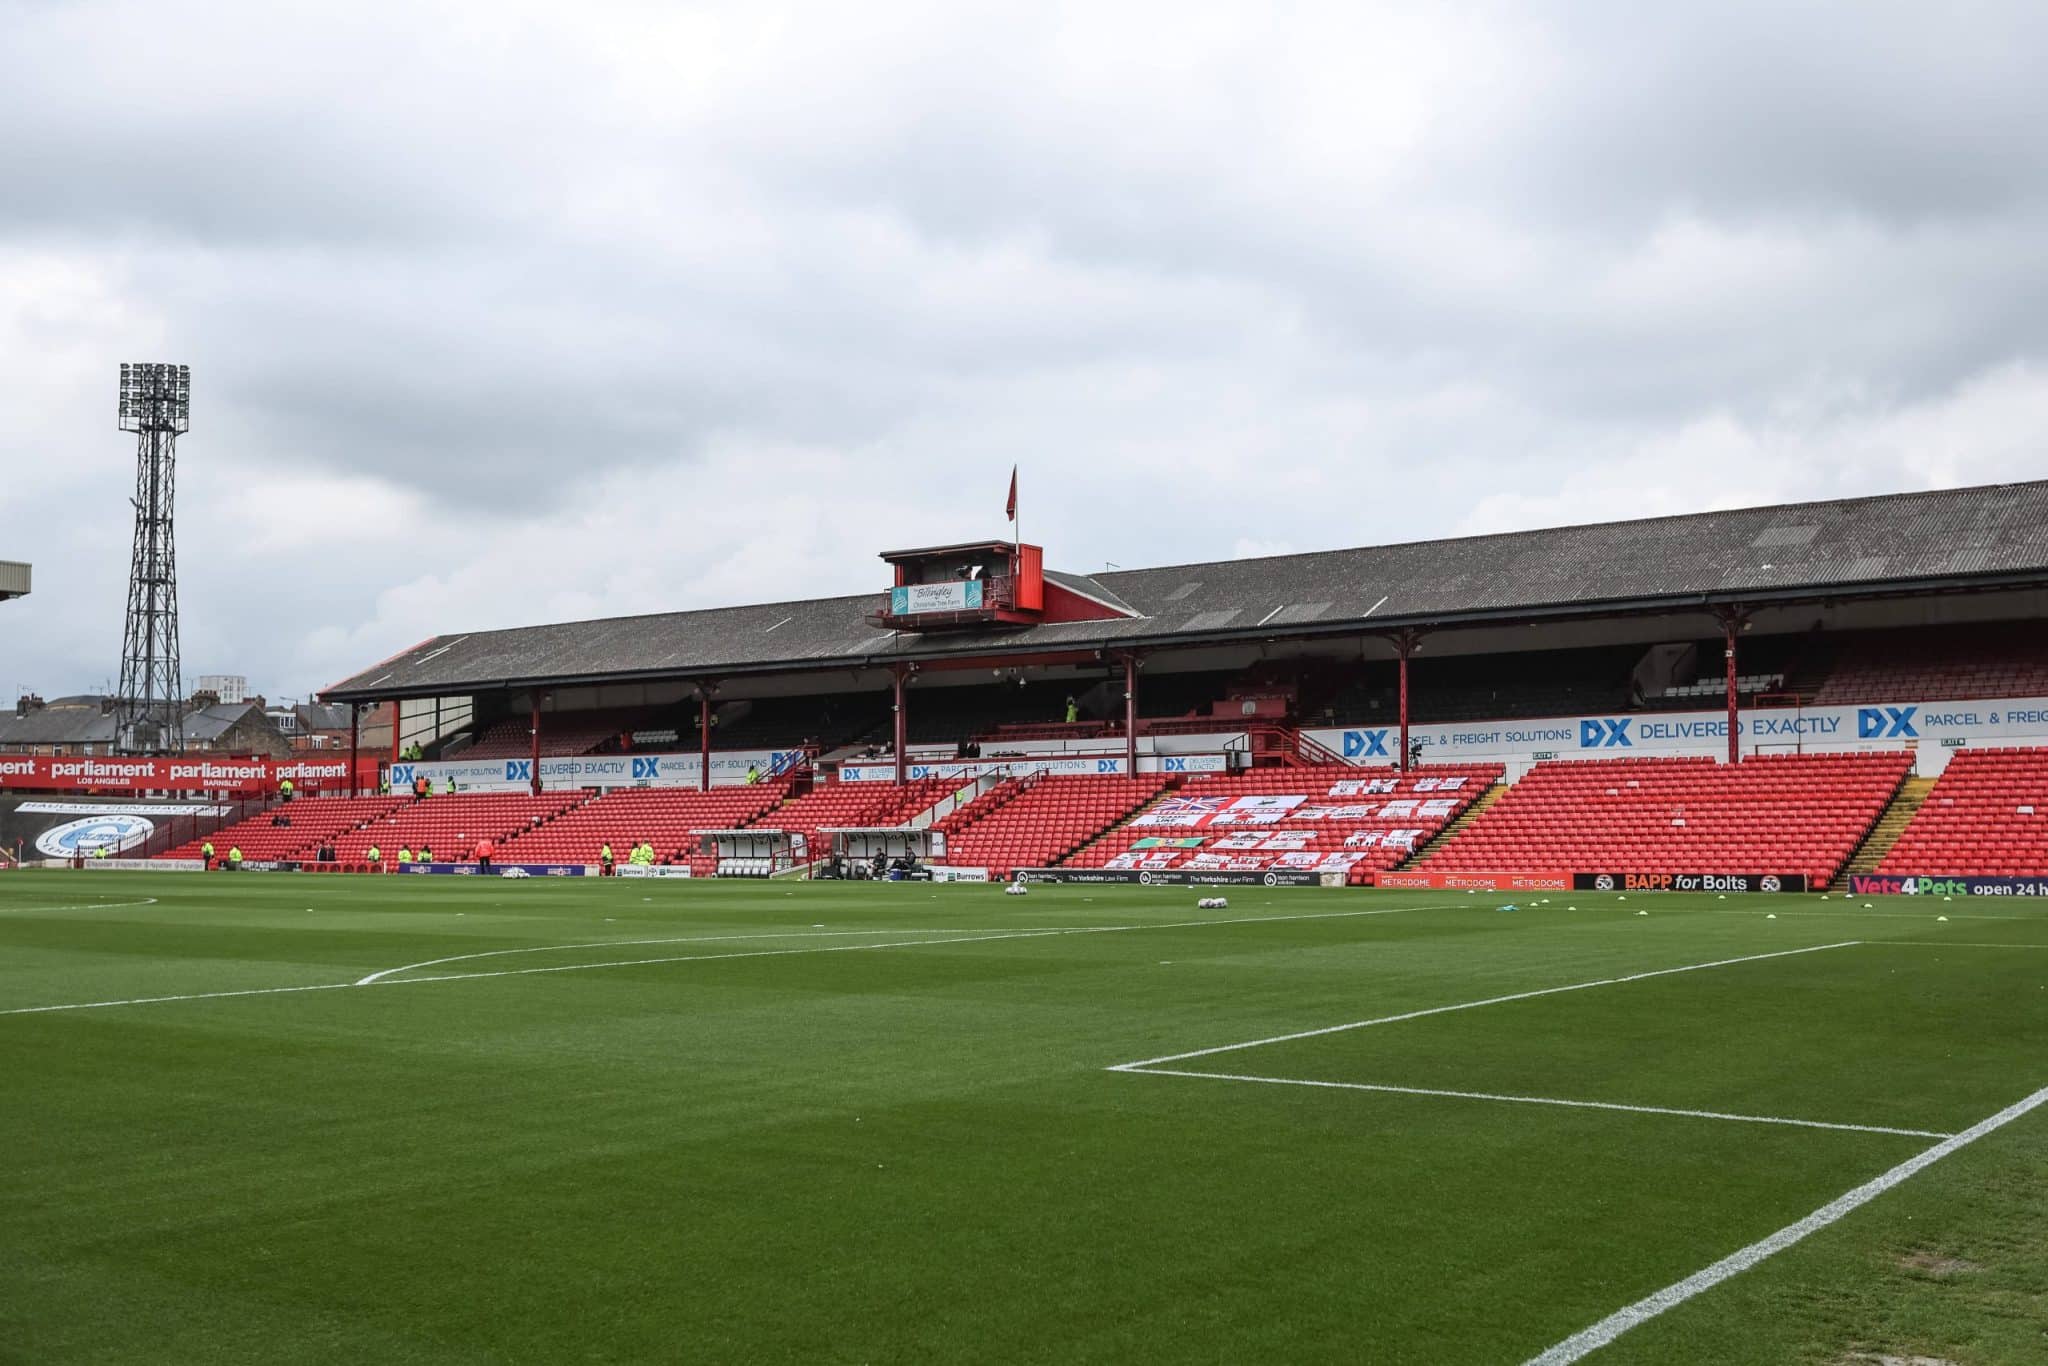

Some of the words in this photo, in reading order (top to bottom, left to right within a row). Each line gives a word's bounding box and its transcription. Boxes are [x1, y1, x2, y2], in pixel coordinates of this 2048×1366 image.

[917, 585, 952, 600] Billingley
[1858, 706, 1919, 738] DX
[1925, 712, 1983, 726] PARCEL
[1989, 712, 2000, 724] &
[1580, 718, 1632, 747] DX
[1753, 716, 1841, 735] EXACTLY
[1344, 729, 1388, 757] DX
[1392, 735, 1435, 747] PRCEL
[1439, 734, 1448, 745] &
[1452, 732, 1500, 745] FREIGHT
[1505, 730, 1572, 743] SOLUTIONS
[0, 759, 36, 775] ent
[51, 760, 155, 779] parliament
[170, 762, 266, 781] parliament
[276, 762, 346, 781] parliament
[506, 761, 530, 780] DX
[540, 763, 582, 775] ELIVERED
[585, 762, 625, 774] EXACTLY
[632, 757, 660, 778] DX
[661, 762, 686, 770] PARCEL
[696, 760, 725, 769] FGHT
[727, 759, 767, 769] SOLUTIONS
[912, 766, 930, 779] DX
[1035, 760, 1086, 770] SOLUTIONS
[1098, 759, 1118, 773] DX
[1165, 757, 1186, 771] DX
[77, 777, 92, 785] LOS
[392, 765, 415, 785] DX
[470, 767, 503, 776] SOLUTIONS
[844, 768, 861, 780] DX
[203, 779, 243, 787] BARNSLEY
[957, 872, 984, 881] Burrows
[1381, 878, 1431, 887] METRODOME
[1445, 879, 1497, 888] METRODOME
[1512, 879, 1567, 888] METRODOME
[1625, 874, 1673, 889] BAPP
[1675, 874, 1700, 889] for
[1703, 875, 1747, 890] Bolts
[1853, 877, 1967, 896] Vets4Pets
[1973, 885, 2013, 897] open
[2016, 883, 2035, 896] 24
